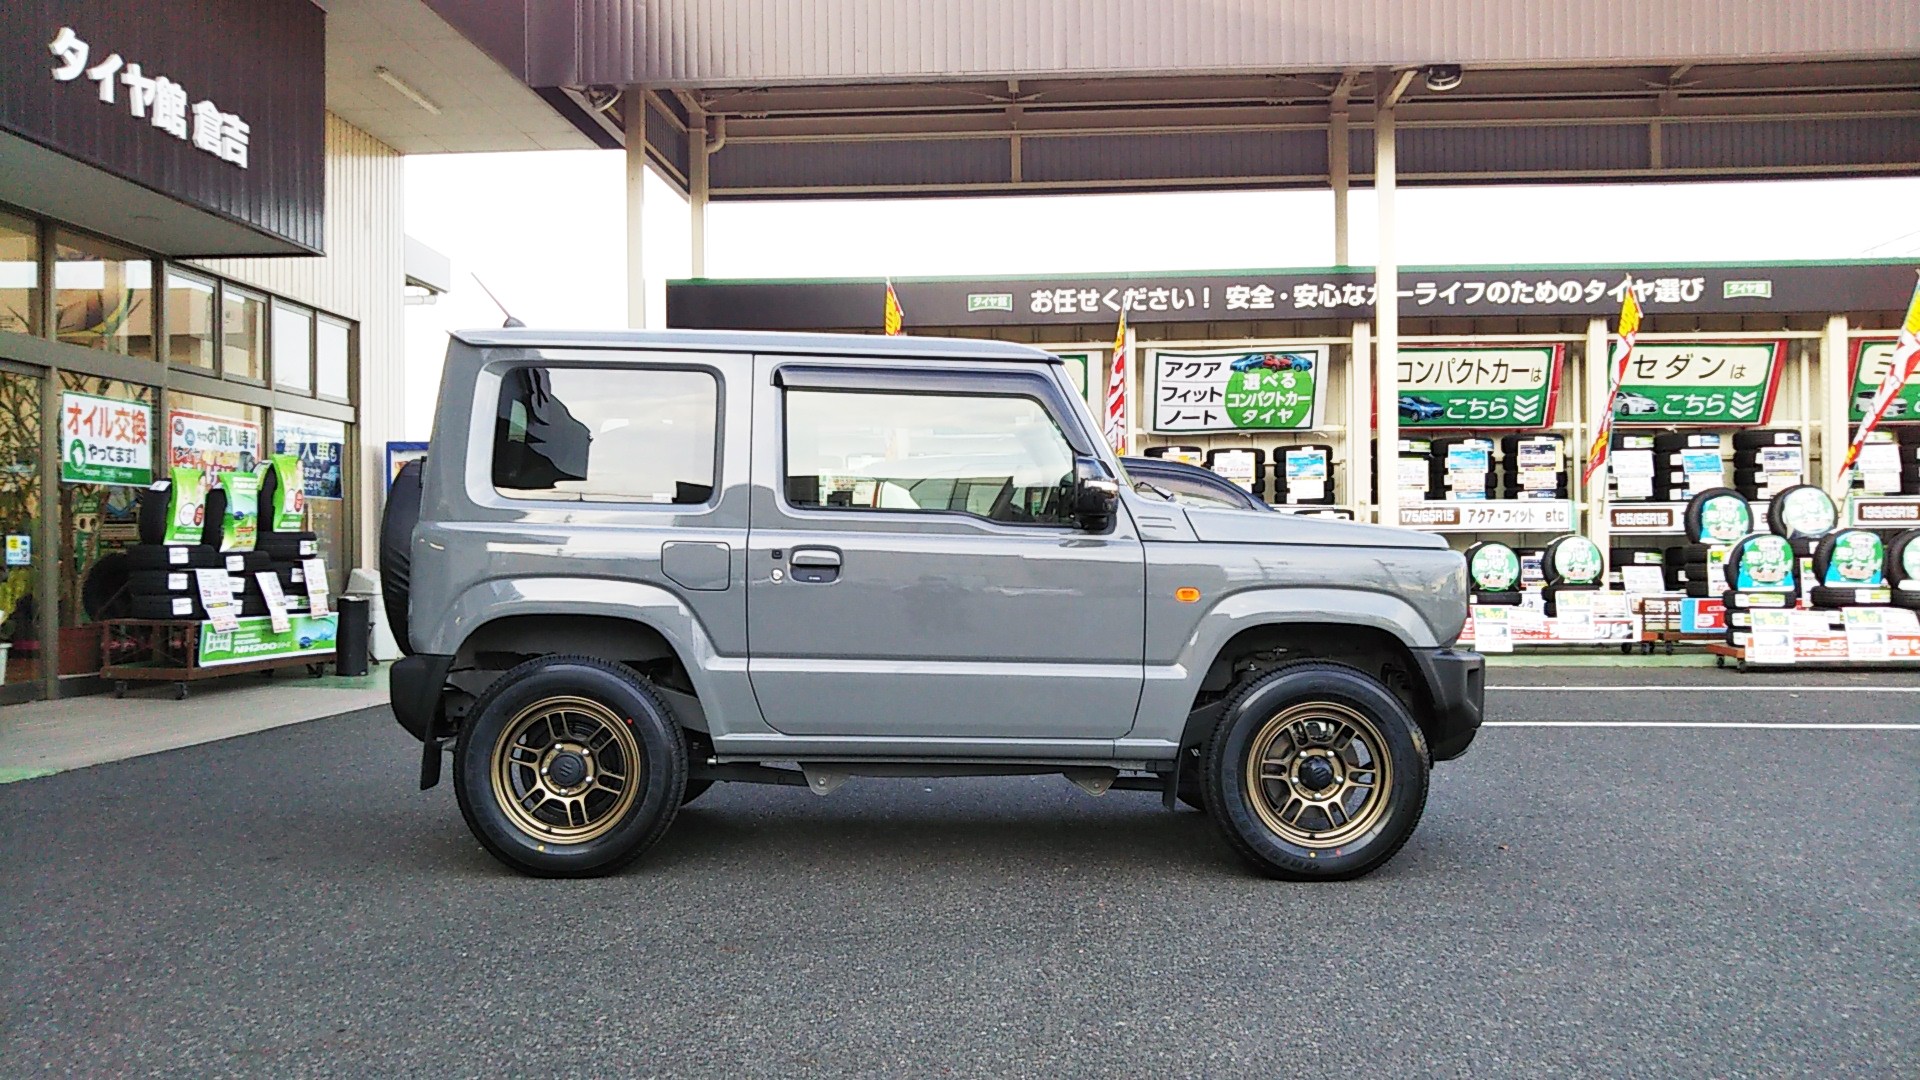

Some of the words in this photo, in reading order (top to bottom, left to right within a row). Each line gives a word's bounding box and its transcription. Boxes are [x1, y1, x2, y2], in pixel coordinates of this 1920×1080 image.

[50, 26, 188, 140] タイヤ館
[192, 100, 251, 169] 倉吉
[1165, 361, 1222, 379] アクア
[1243, 372, 1297, 391] 選べる
[1162, 387, 1223, 403] フィット
[1227, 391, 1311, 408] コンパクトカー
[1447, 397, 1509, 420] こちら
[1663, 394, 1726, 416] こちら
[67, 402, 147, 446] オイル交換
[1164, 410, 1217, 426] ノート
[1242, 408, 1294, 425] タイヤ
[1545, 510, 1565, 522] etc
